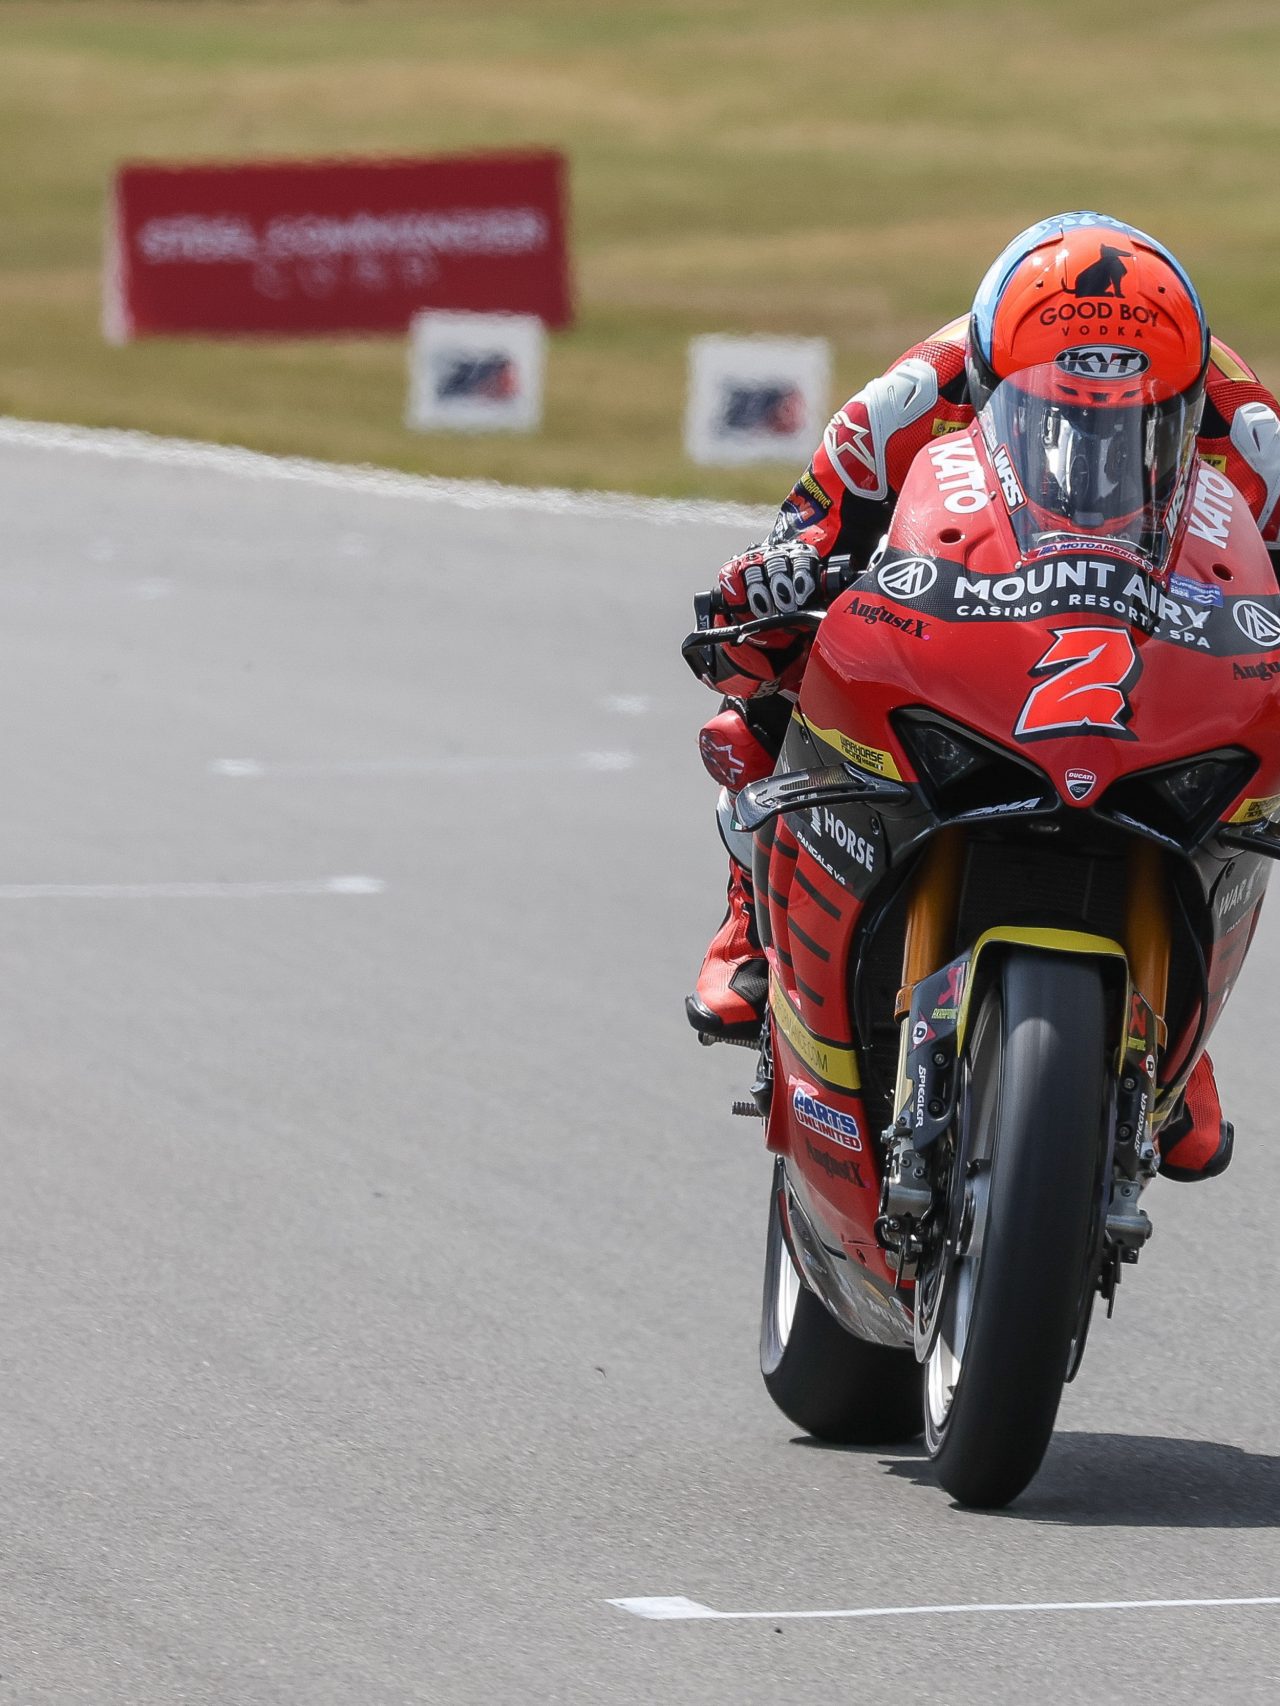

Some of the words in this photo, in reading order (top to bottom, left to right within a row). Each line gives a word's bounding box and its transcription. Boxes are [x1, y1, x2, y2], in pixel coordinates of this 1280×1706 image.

[1040, 302, 1113, 326] GOOD
[1120, 303, 1159, 327] BOY
[1062, 325, 1143, 338] VODKA
[1066, 351, 1141, 373] KYT
[928, 436, 990, 514] KATO
[993, 447, 1025, 508] WRS
[1188, 469, 1234, 550] KATO
[953, 560, 1116, 602] MOUNT
[1122, 573, 1212, 629] AIRY
[956, 602, 1043, 618] CASINO
[1068, 594, 1149, 627] RESORT
[1169, 629, 1211, 649] SPA
[1012, 626, 1143, 743] 2
[1068, 772, 1093, 781] DUCATI
[824, 806, 875, 873] HORSE
[794, 1088, 859, 1137] PARTS
[915, 1064, 927, 1129] SPIEGLER
[796, 1111, 861, 1149] UNLIMITED
